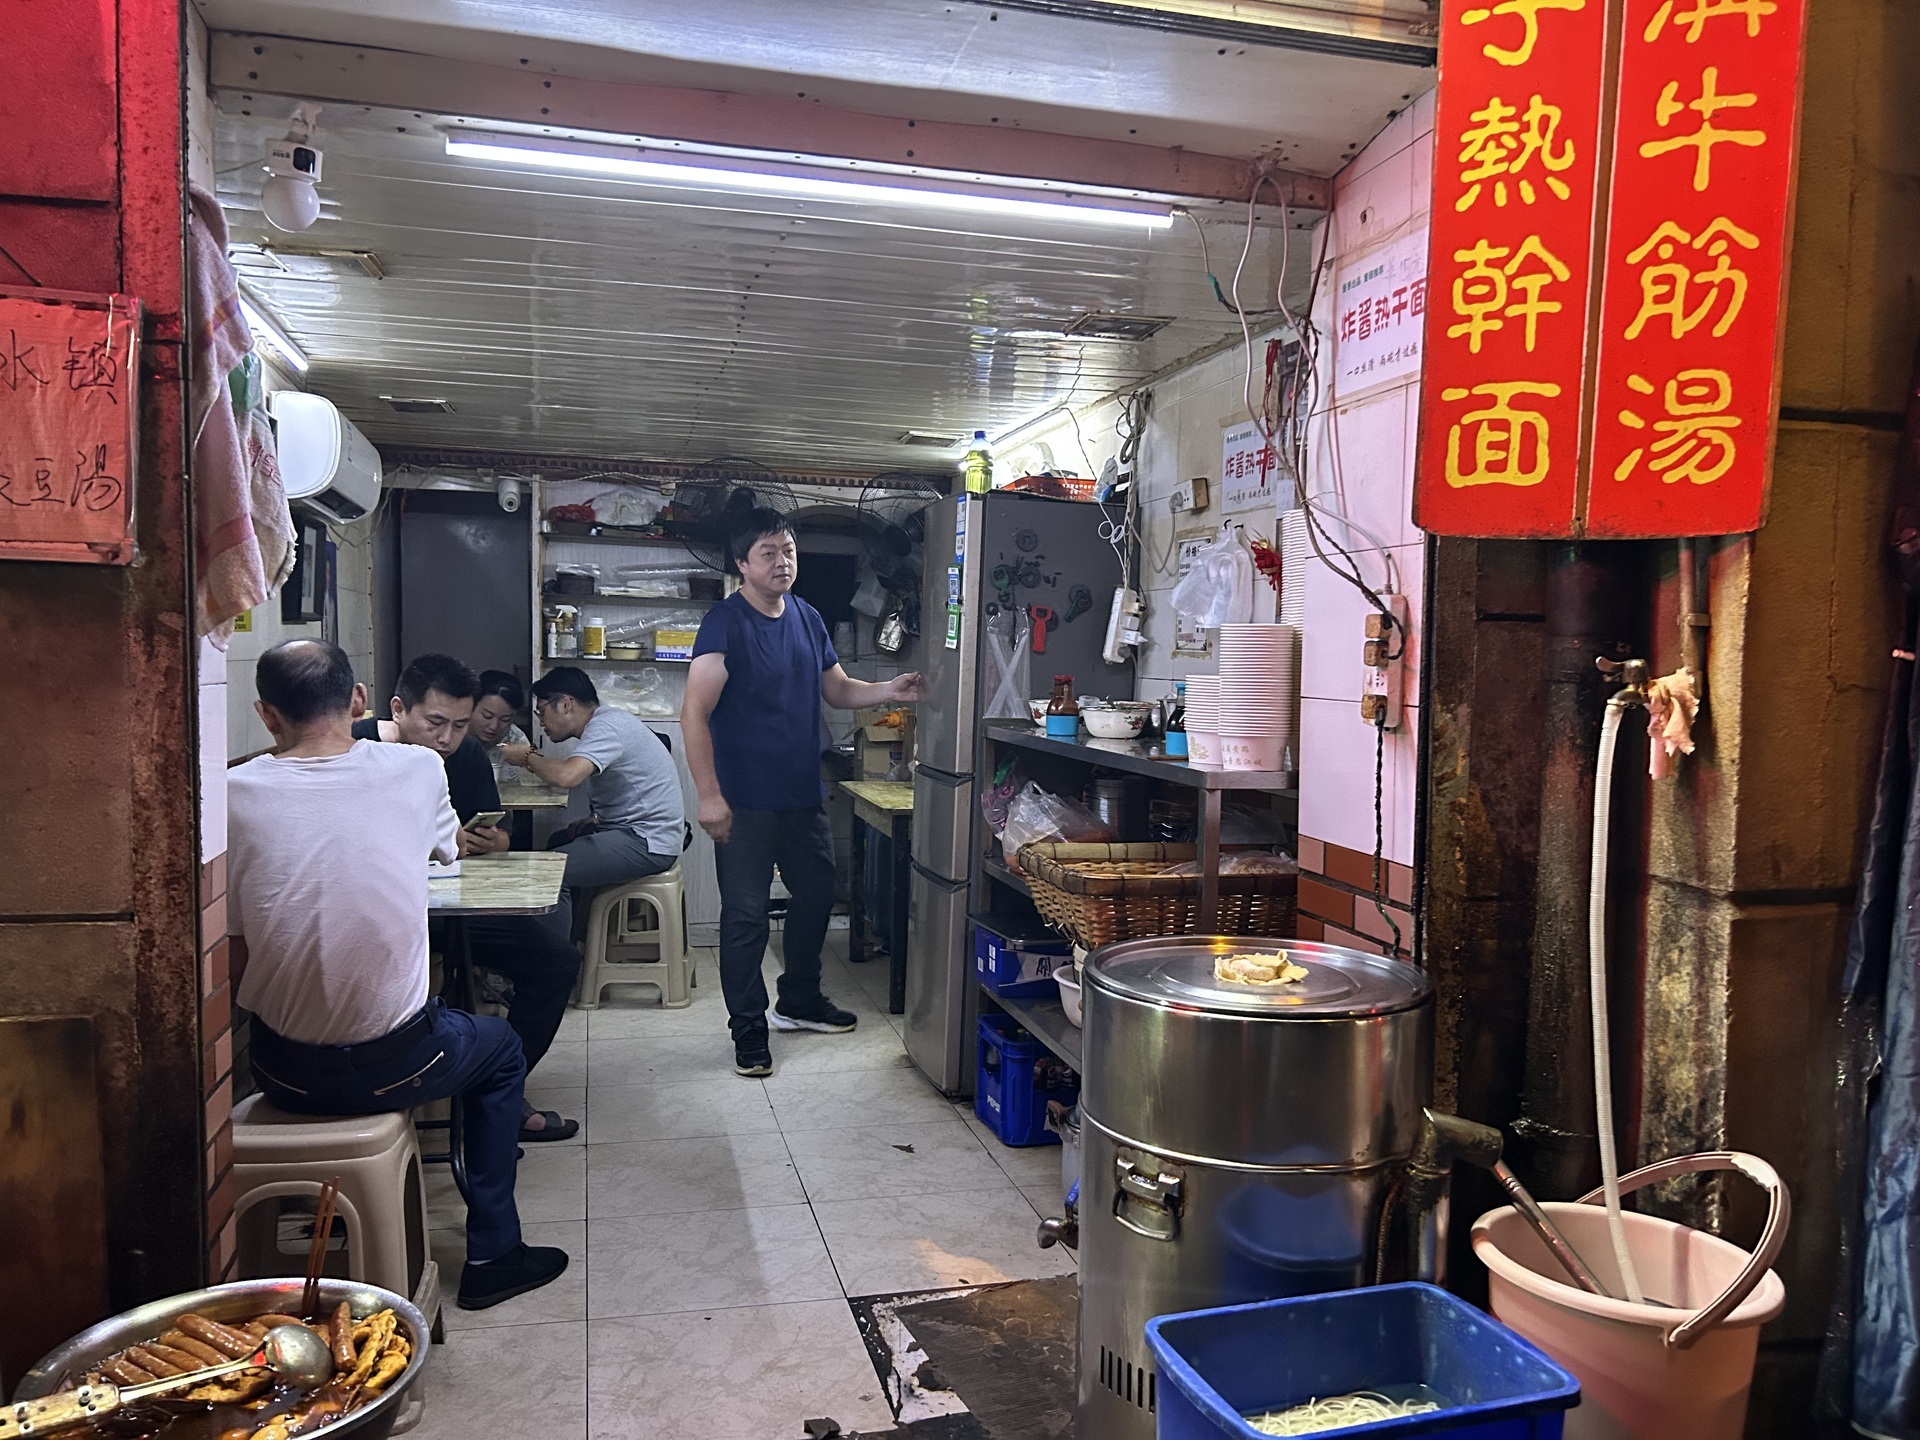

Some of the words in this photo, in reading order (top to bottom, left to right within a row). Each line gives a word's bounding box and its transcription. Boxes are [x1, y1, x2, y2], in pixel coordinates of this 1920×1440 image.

[1341, 277, 1427, 343] 炸酱热干面
